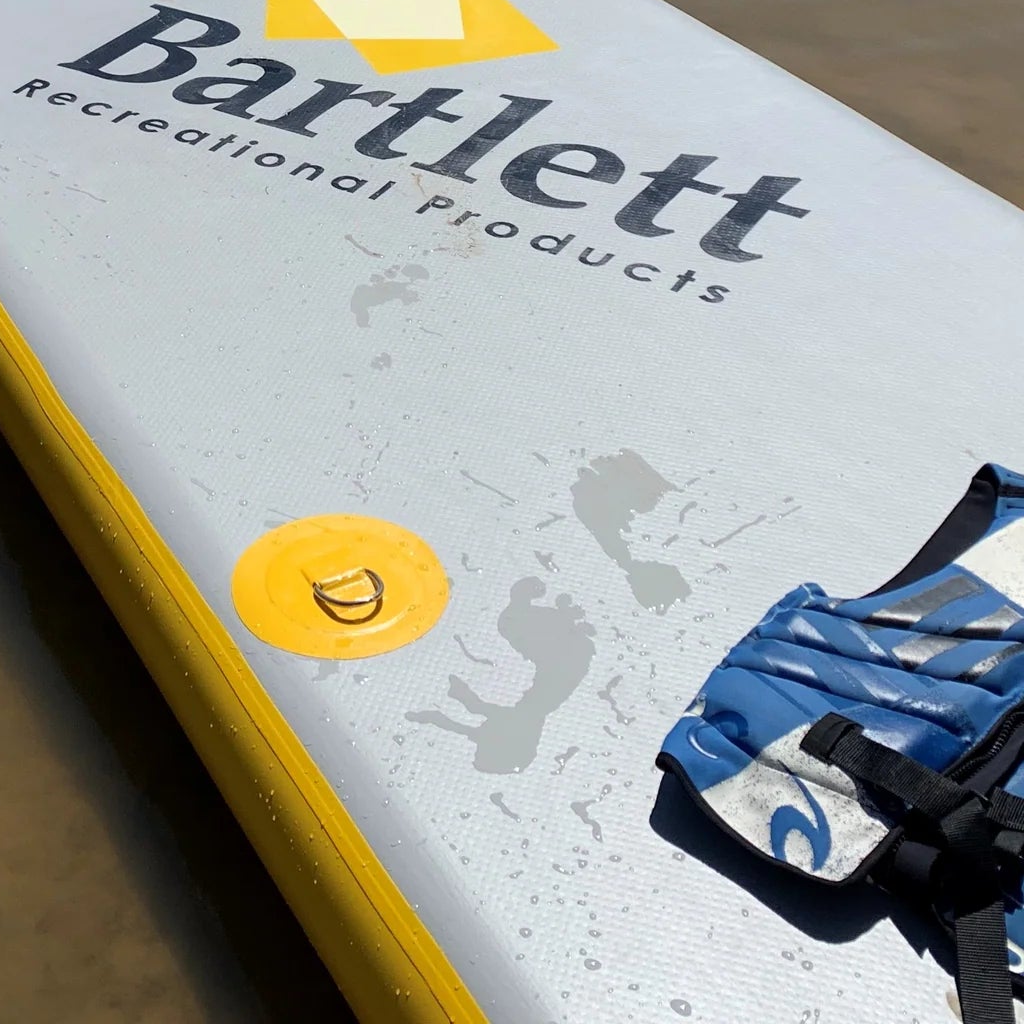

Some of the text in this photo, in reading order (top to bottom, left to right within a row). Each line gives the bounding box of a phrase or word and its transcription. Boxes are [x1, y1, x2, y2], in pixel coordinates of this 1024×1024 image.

[12, 78, 731, 304] Recreational Products
[58, 4, 810, 263] Bartlett
